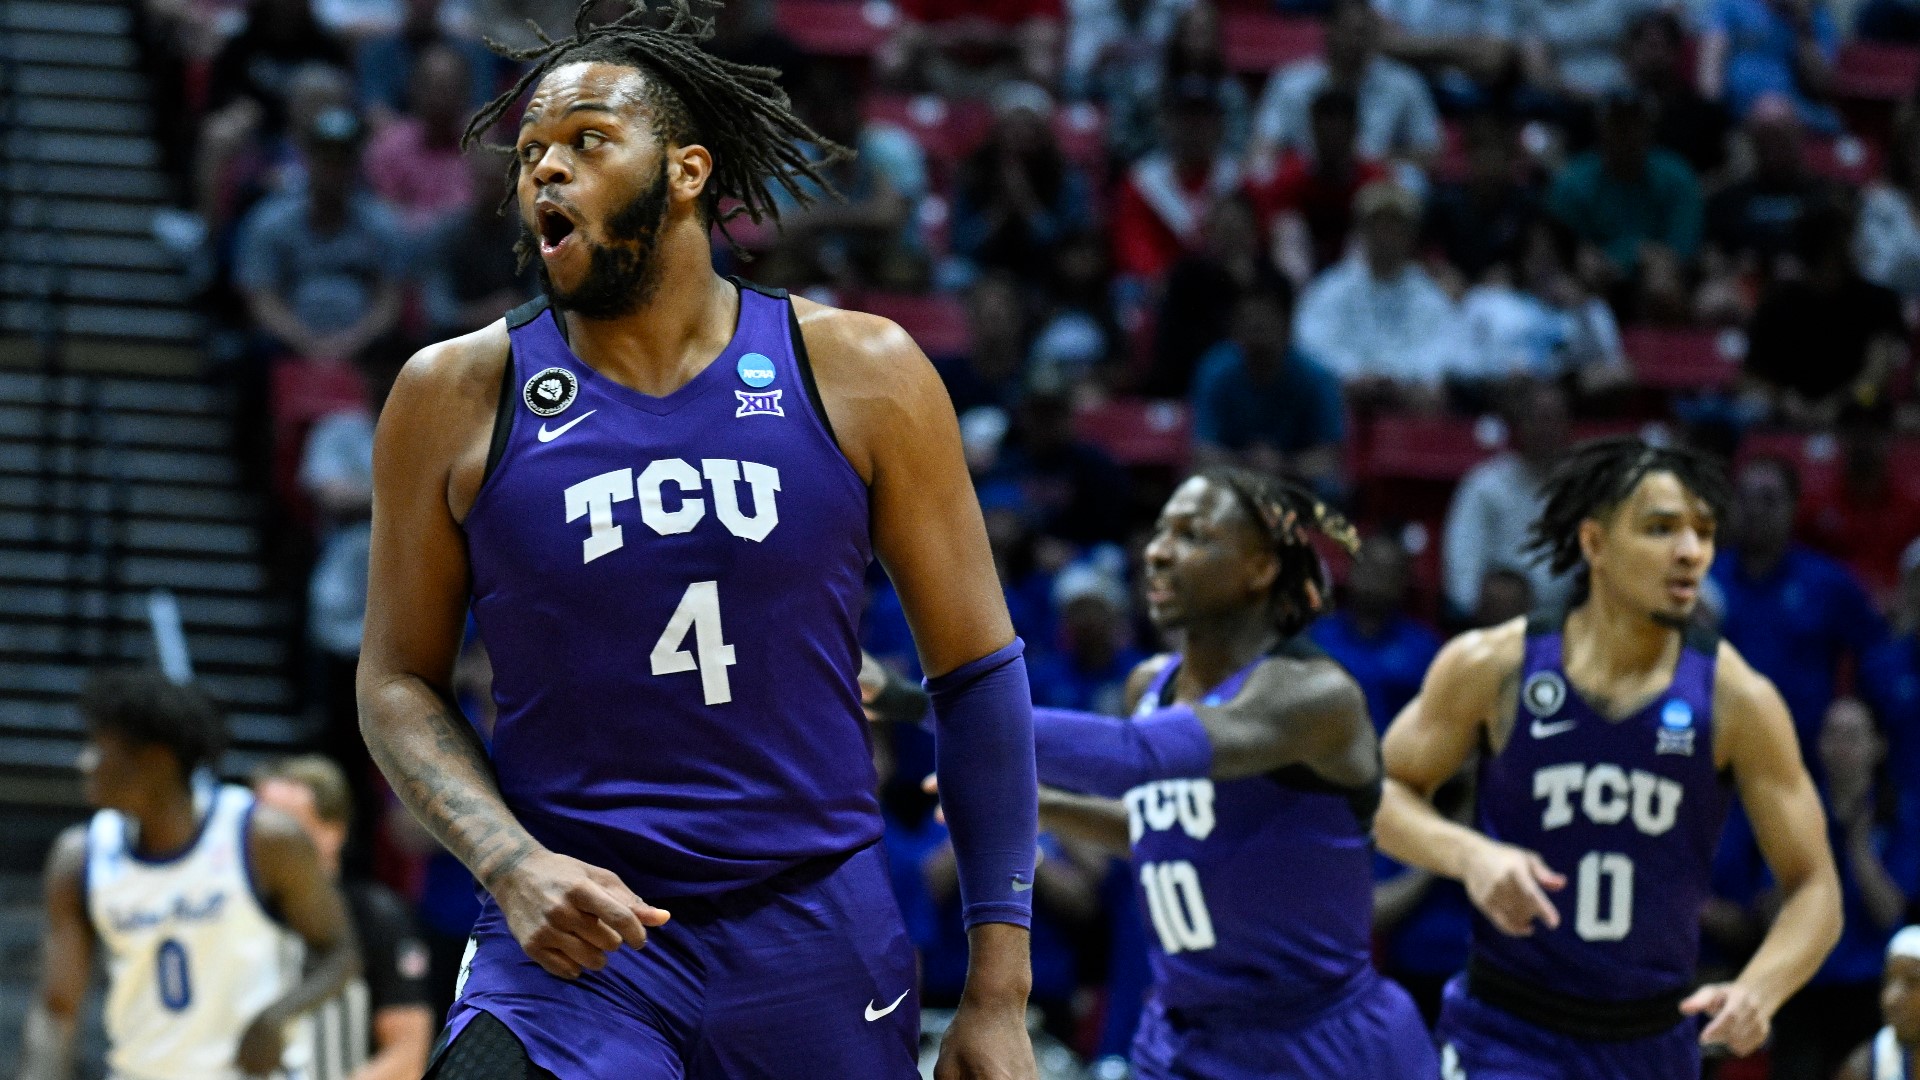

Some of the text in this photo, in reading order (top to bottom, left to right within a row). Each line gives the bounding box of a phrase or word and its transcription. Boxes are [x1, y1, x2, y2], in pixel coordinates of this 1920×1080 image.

[564, 458, 781, 564] TCU
[650, 580, 737, 705] 4
[1124, 777, 1216, 844] TCU
[1533, 761, 1684, 837] TCU
[1140, 860, 1217, 955] 10
[1575, 851, 1634, 942] 0
[156, 938, 192, 1013] 0
